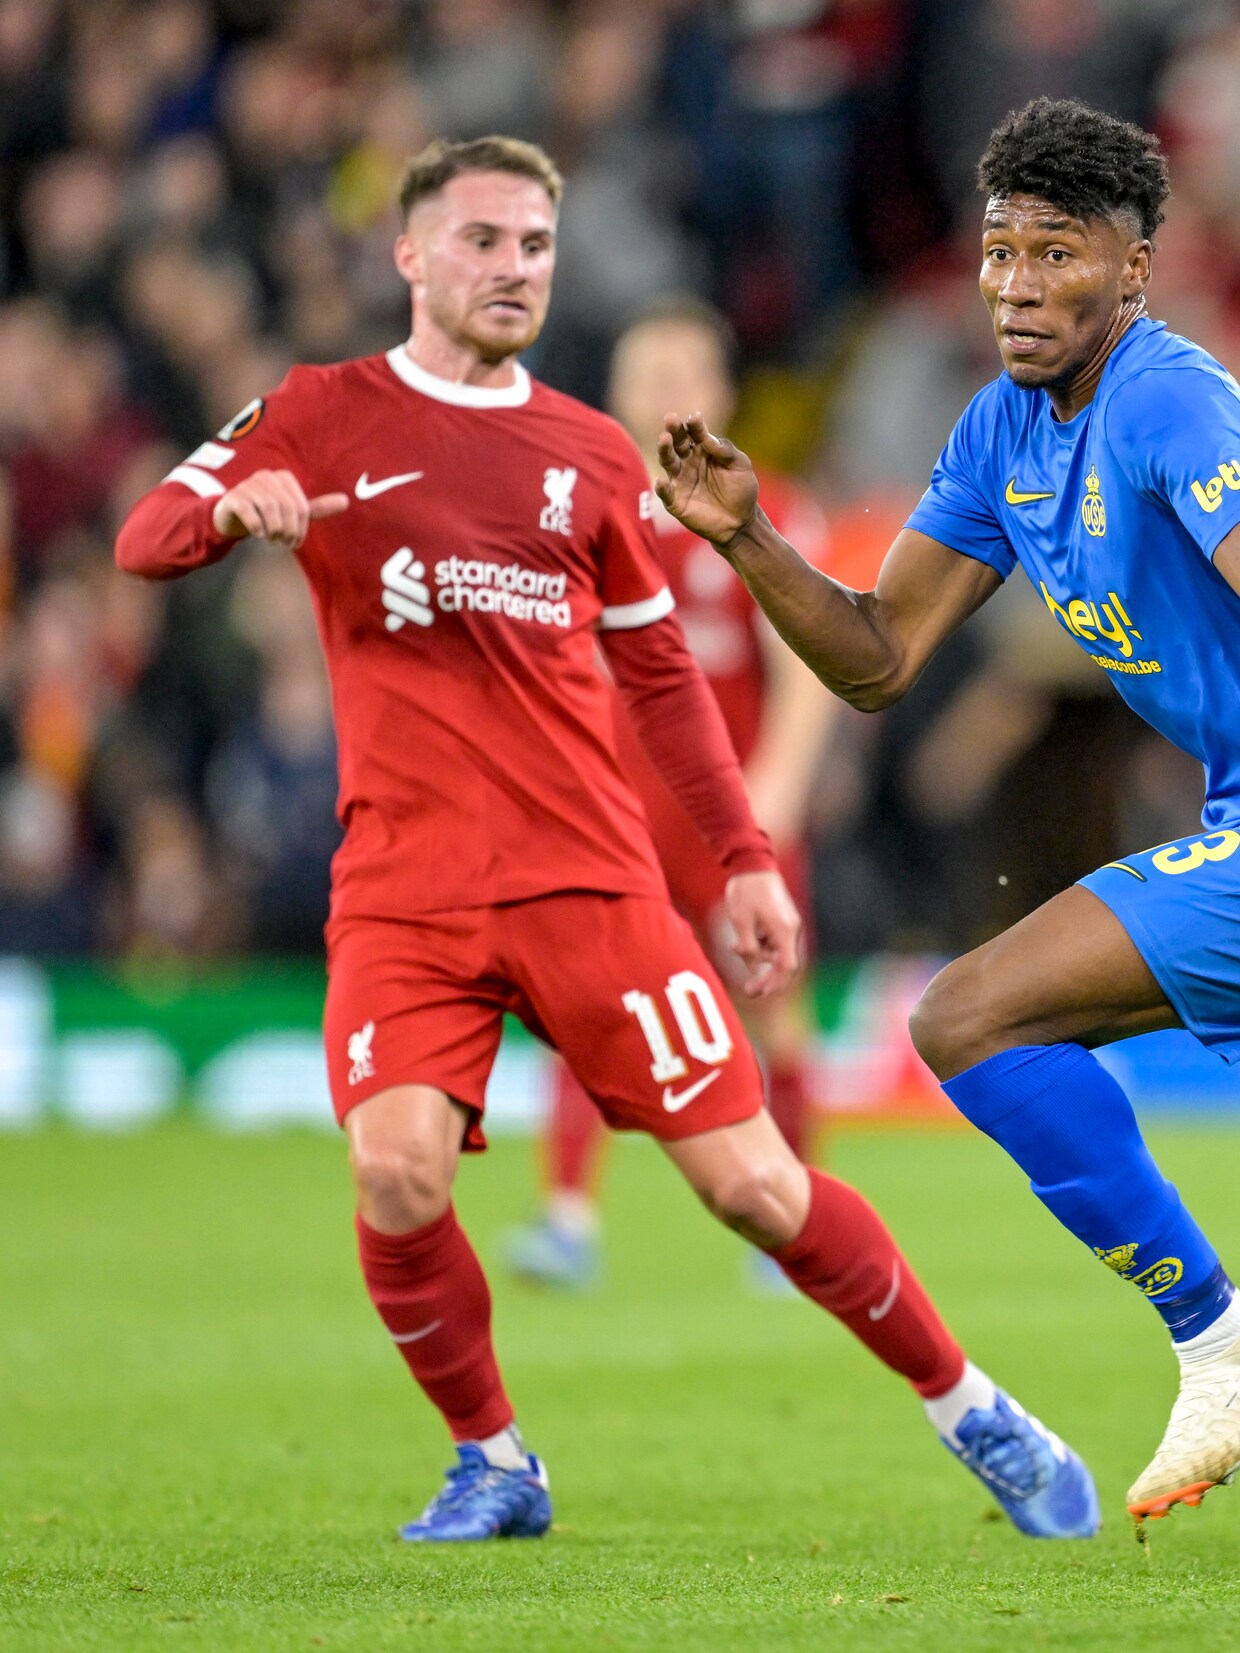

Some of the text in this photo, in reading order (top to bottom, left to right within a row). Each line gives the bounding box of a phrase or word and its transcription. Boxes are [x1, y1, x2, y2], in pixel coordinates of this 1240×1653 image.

[434, 555, 567, 600] standard
[437, 584, 572, 628] chartered
[1039, 580, 1144, 658] hey!
[1138, 829, 1240, 875] 3
[621, 969, 734, 1084] 10
